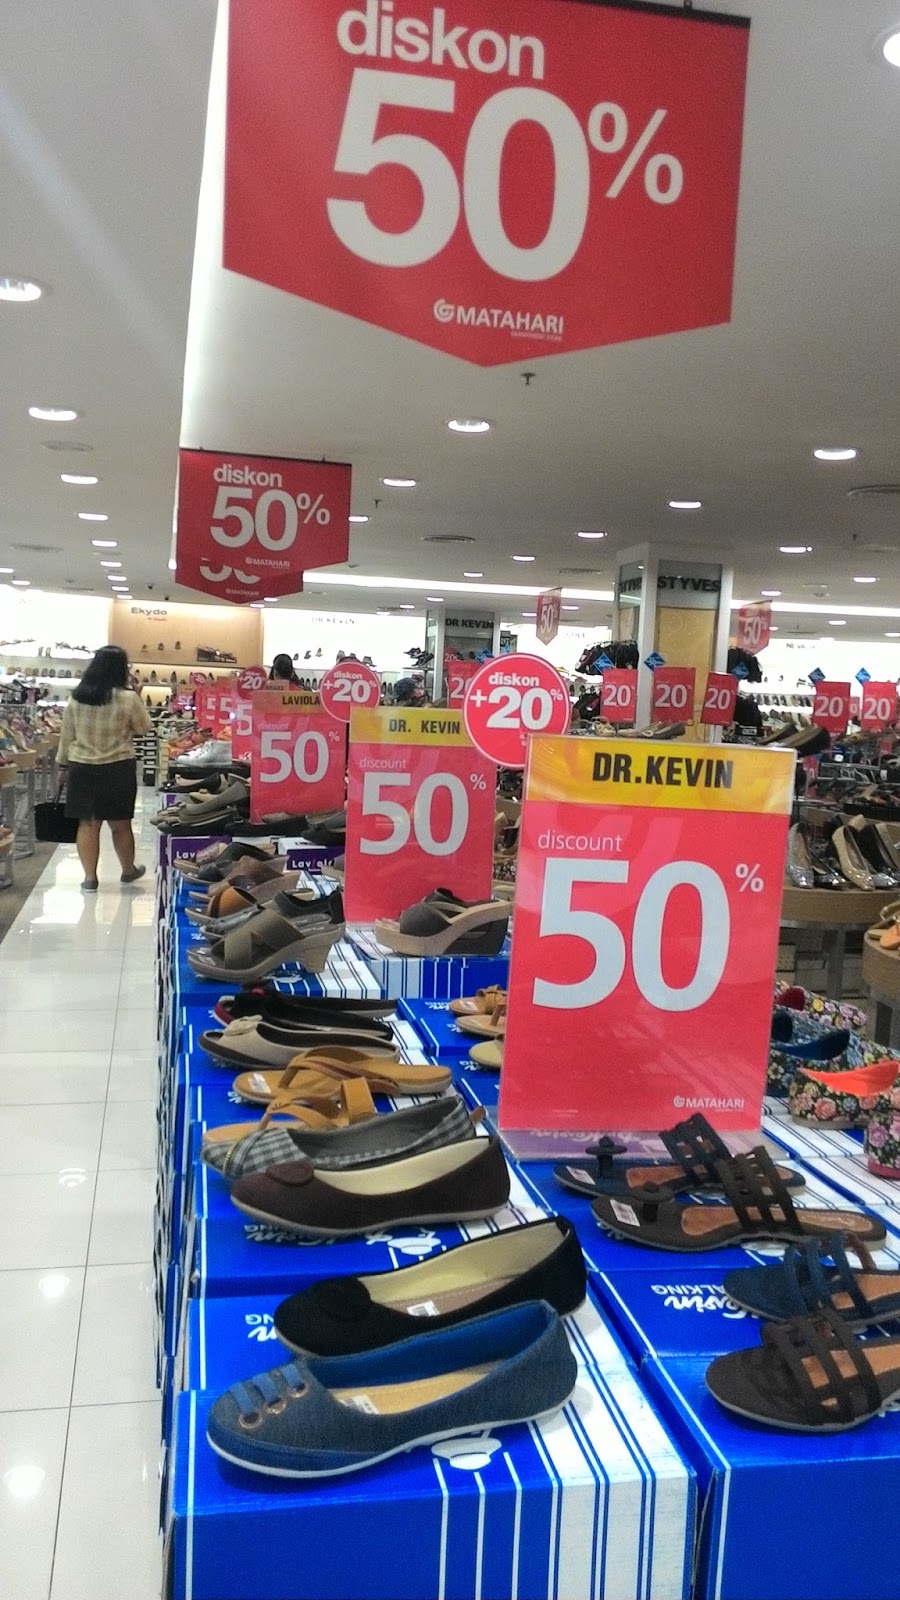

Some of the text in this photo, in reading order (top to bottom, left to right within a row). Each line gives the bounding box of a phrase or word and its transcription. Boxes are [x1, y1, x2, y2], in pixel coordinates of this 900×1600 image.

[337, 0, 545, 79] diskon
[457, 305, 564, 334] MATAHARI
[213, 464, 282, 487] diskon
[253, 558, 290, 568] MATAHARI
[658, 576, 721, 592] STYVES
[446, 619, 459, 627] DR
[461, 620, 494, 629] KEVIN
[333, 671, 363, 679] diskon
[488, 672, 540, 687] diskon
[282, 696, 320, 705] LAVIOLA
[389, 719, 461, 734] DR. KEVIN
[359, 756, 407, 769] discount
[537, 829, 623, 852] discount
[686, 1098, 745, 1109] MATAHARI
[651, 1284, 726, 1295] ALKING
